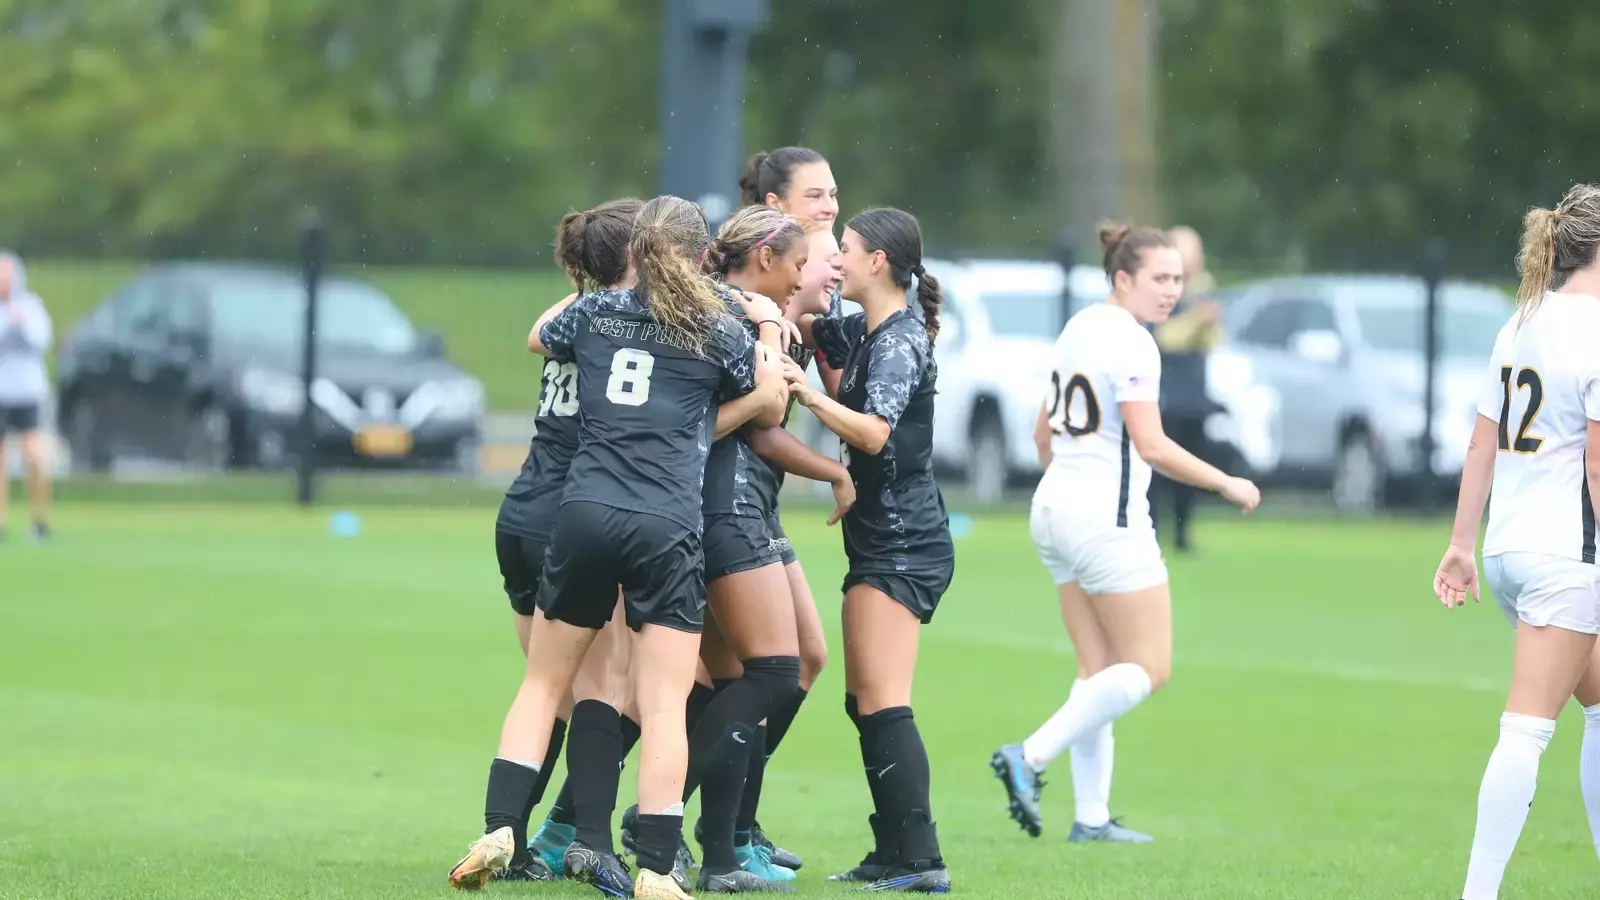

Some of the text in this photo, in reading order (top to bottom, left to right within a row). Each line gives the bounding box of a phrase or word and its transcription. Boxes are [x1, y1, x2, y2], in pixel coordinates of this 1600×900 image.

[539, 360, 579, 416] 30
[605, 347, 655, 406] 8
[1048, 370, 1101, 438] 20
[1498, 365, 1545, 455] 12
